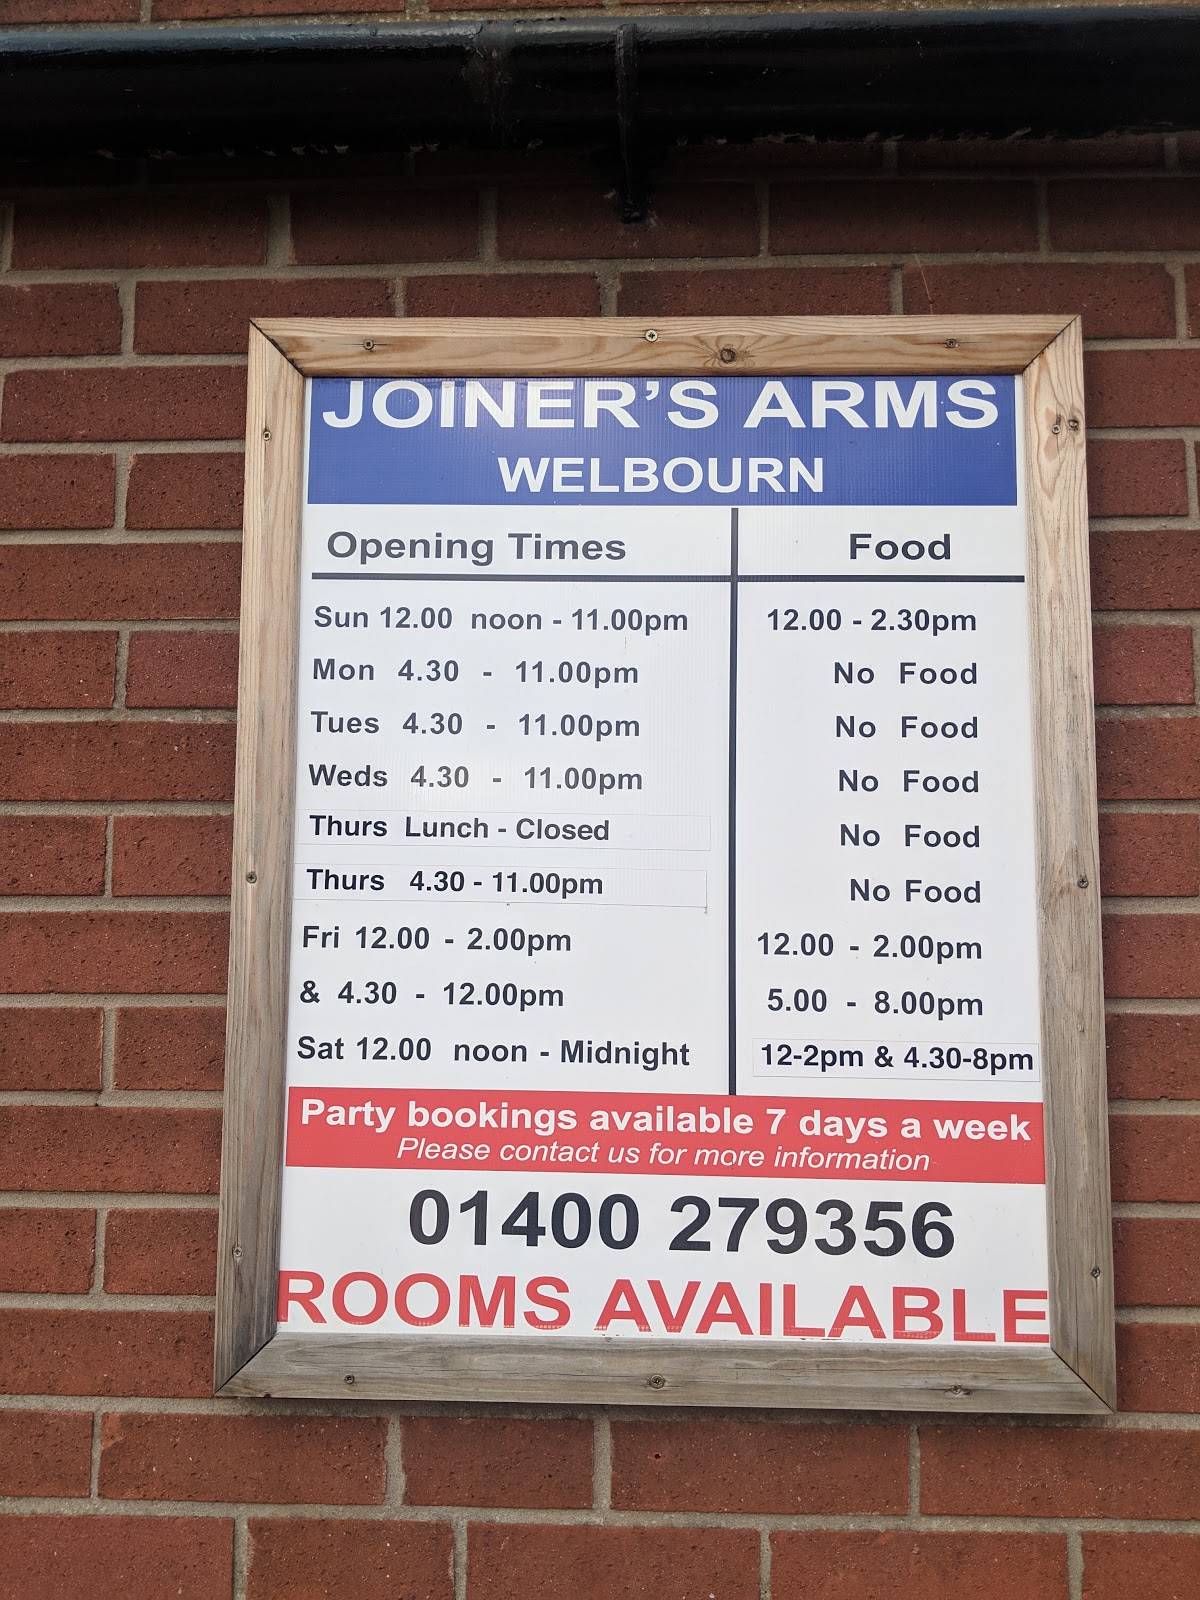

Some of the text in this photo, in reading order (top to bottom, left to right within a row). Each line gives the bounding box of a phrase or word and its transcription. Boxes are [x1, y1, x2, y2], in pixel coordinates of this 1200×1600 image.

[743, 379, 999, 429] ARMS
[497, 456, 823, 494] WELBOURN
[327, 531, 626, 567] Opening Times
[849, 533, 951, 561] Food
[314, 605, 369, 628] Sun
[380, 606, 453, 630] 12.00
[471, 613, 542, 630] noon
[571, 608, 688, 637] 11.00pm
[767, 608, 842, 631] 12.00
[870, 608, 977, 637] 2.30pm
[313, 658, 374, 681] Mon
[397, 659, 459, 682] 4.30
[515, 660, 638, 689] 11.00pm
[834, 661, 977, 685] No Food
[310, 710, 380, 734] Tues
[402, 712, 463, 735] 4.30
[518, 713, 640, 742] 11.00pm
[836, 715, 978, 739] No Food
[308, 763, 388, 787] Weds
[410, 765, 469, 788] 4.30
[524, 766, 643, 796] 11.00pm
[839, 769, 979, 793] No Food
[309, 814, 388, 837] Thurs
[405, 816, 489, 839] Lunch
[516, 817, 610, 841] Closed
[840, 823, 980, 848] No Food
[306, 868, 385, 891] Thurs
[409, 870, 465, 892] 4.30
[492, 871, 603, 900] 11.00pm
[850, 878, 981, 904] No Food
[302, 925, 340, 949] Fri
[355, 926, 430, 950] 12.00
[466, 927, 571, 957] 2.00pm
[757, 932, 834, 957] 12.00
[873, 934, 982, 965] 2.00pm
[299, 980, 321, 1004] &
[337, 980, 397, 1005] 4.30
[443, 982, 564, 1012] 12.00pm
[767, 988, 827, 1013] 5.00
[874, 990, 983, 1021] 8.00pm
[297, 1035, 345, 1060] Sat
[356, 1036, 432, 1061] 12.00
[454, 1043, 527, 1063] noon
[560, 1039, 690, 1072] Midnight
[761, 1043, 1034, 1075] 12-2pm & 4.30-8pm
[301, 1098, 1032, 1144] Party bookings available 7 days a week
[396, 1137, 930, 1171] Please contact us for more information
[409, 1189, 955, 1259] 01400 279356
[276, 1269, 1051, 1344] ROOMS AVAILABLE
